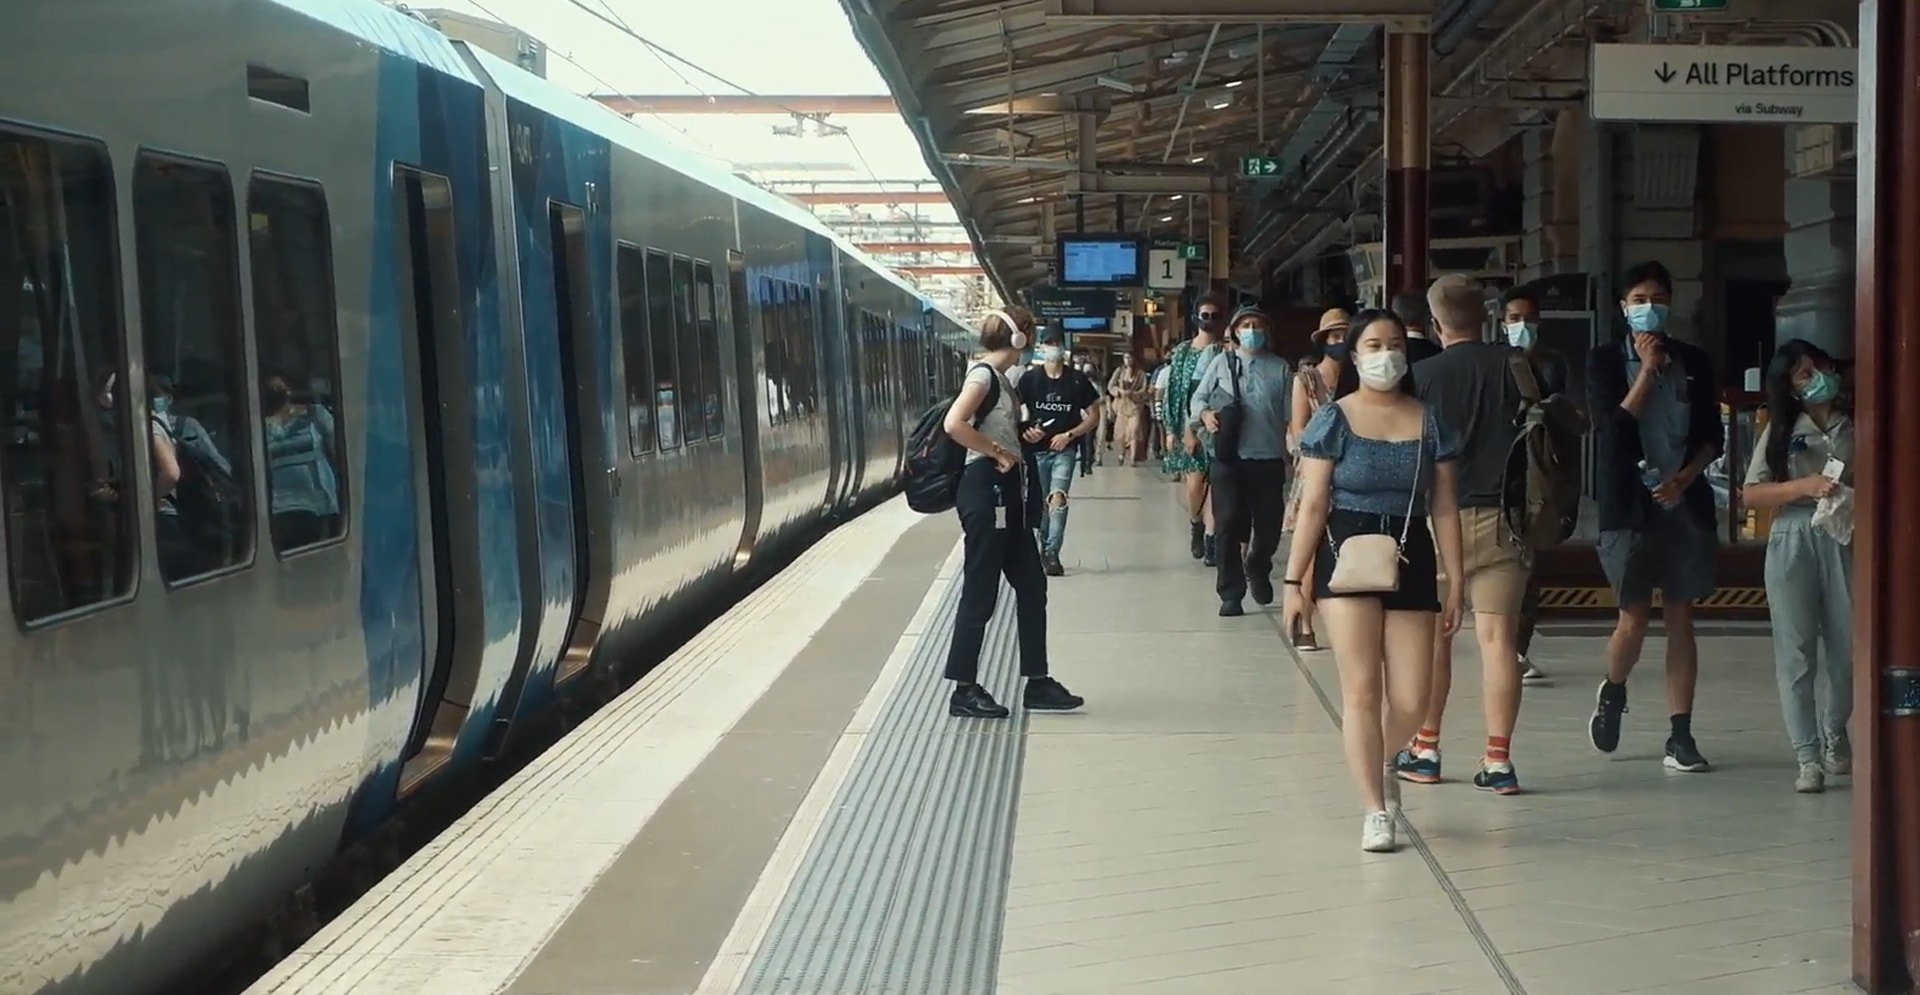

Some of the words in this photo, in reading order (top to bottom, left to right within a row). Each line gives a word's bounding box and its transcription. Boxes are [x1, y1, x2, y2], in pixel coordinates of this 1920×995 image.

[1685, 62, 1718, 85] All
[1726, 63, 1855, 87] Platforms
[1735, 103, 1752, 114] via
[1755, 103, 1803, 117] Subway
[1162, 259, 1173, 279] 1
[1121, 315, 1127, 328] 1
[1035, 400, 1073, 412] LACOSTE
